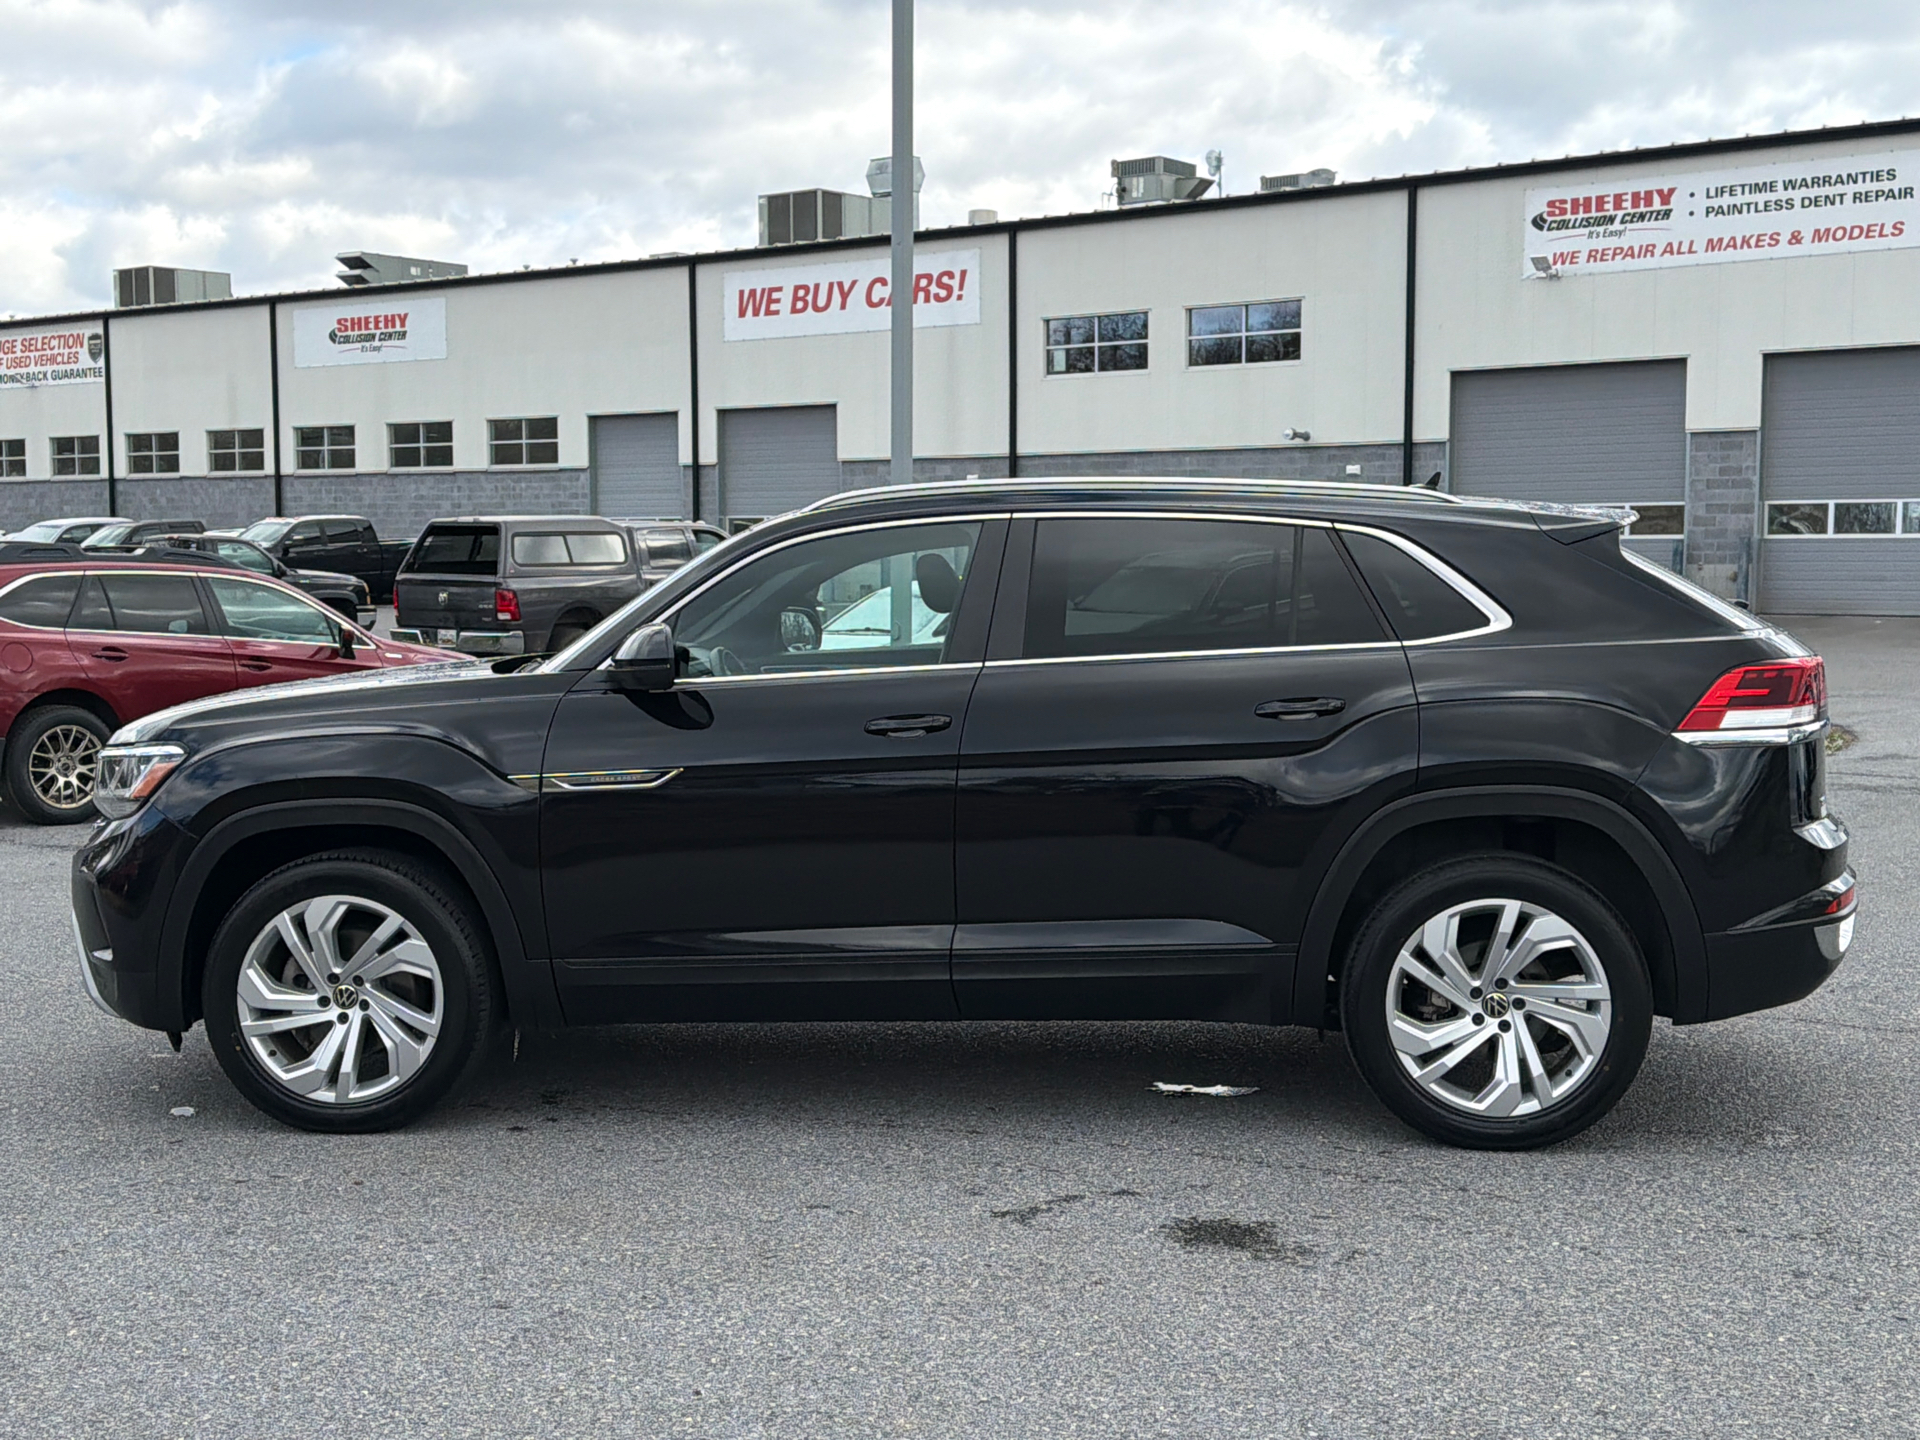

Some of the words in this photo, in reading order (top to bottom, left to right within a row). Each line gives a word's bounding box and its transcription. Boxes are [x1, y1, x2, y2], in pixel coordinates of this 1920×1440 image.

[1705, 180, 1779, 200] LIFETIME
[1782, 168, 1897, 192] WARRANTIES
[1546, 187, 1678, 218] SHEEHY
[1705, 198, 1795, 218] PAINTLESS
[1800, 193, 1848, 209] DENT
[1852, 186, 1915, 205] REPAIR
[1546, 213, 1618, 232] COLLISION
[1619, 208, 1674, 225] CENTER
[1551, 250, 1582, 266] WE
[1586, 243, 1657, 264] REPAIR
[1660, 239, 1698, 258] ALL
[1704, 231, 1781, 254] MAKES
[1787, 229, 1805, 246] &
[1811, 220, 1905, 244] MODELS
[1587, 228, 1601, 240] It's
[1602, 226, 1627, 239] Easy!
[737, 286, 784, 319] WE
[790, 279, 859, 315] BUY
[865, 269, 968, 309] CRS!
[336, 312, 409, 333] SHEEHY
[20, 332, 85, 354] SELECTION
[337, 332, 376, 345] COLLISION
[378, 330, 408, 342] CENTER
[6, 355, 32, 370] USED
[33, 351, 80, 368] VEHICLES
[25, 370, 49, 383] BACK
[50, 366, 104, 381] GUARANTEE
